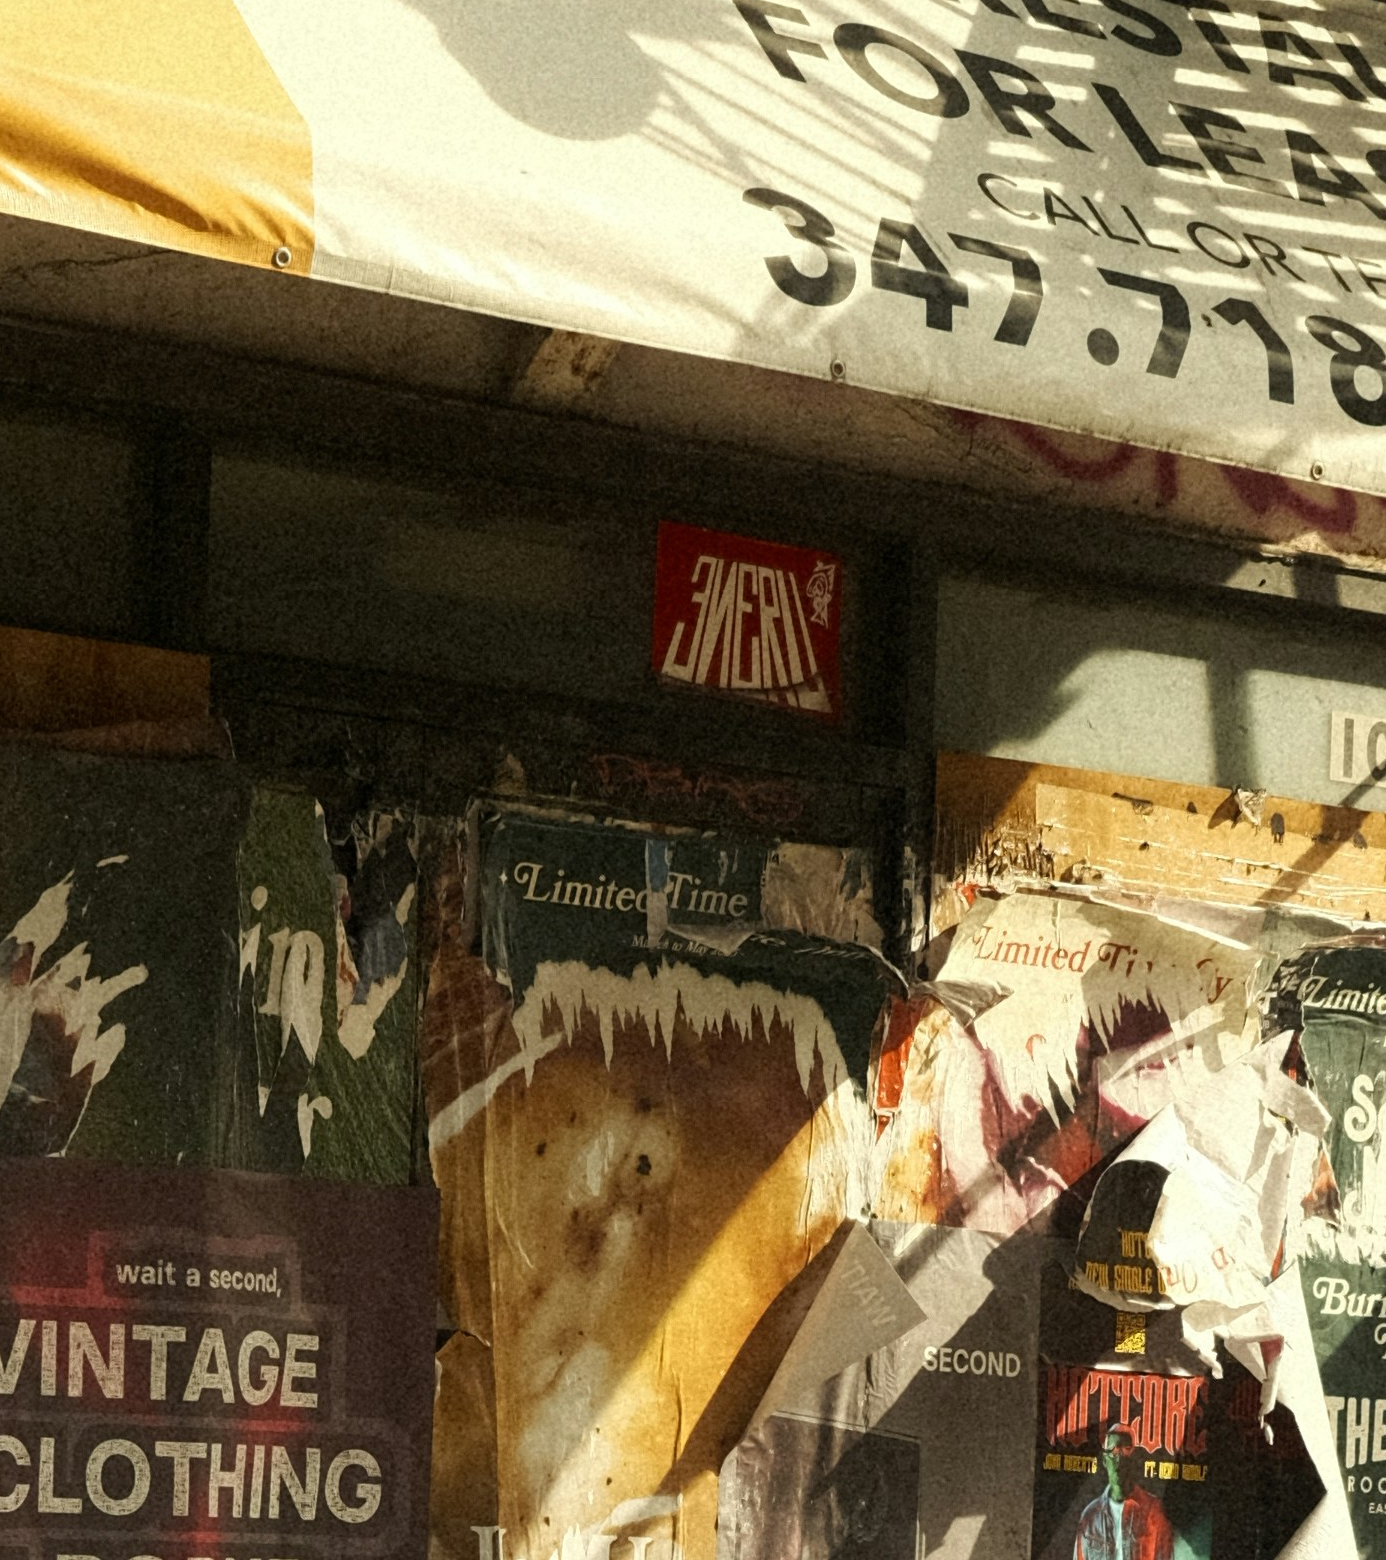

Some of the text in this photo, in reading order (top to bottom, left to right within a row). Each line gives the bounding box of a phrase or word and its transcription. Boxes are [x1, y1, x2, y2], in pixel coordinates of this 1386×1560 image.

[977, 172, 1180, 253] CALL
[1186, 221, 1305, 282] OR
[666, 873, 747, 917] Time
[974, 926, 1091, 973] Limited
[116, 1260, 282, 1297] wait a second,
[923, 1346, 1020, 1378] SECOND
[1047, 1365, 1208, 1455] HOTCORE
